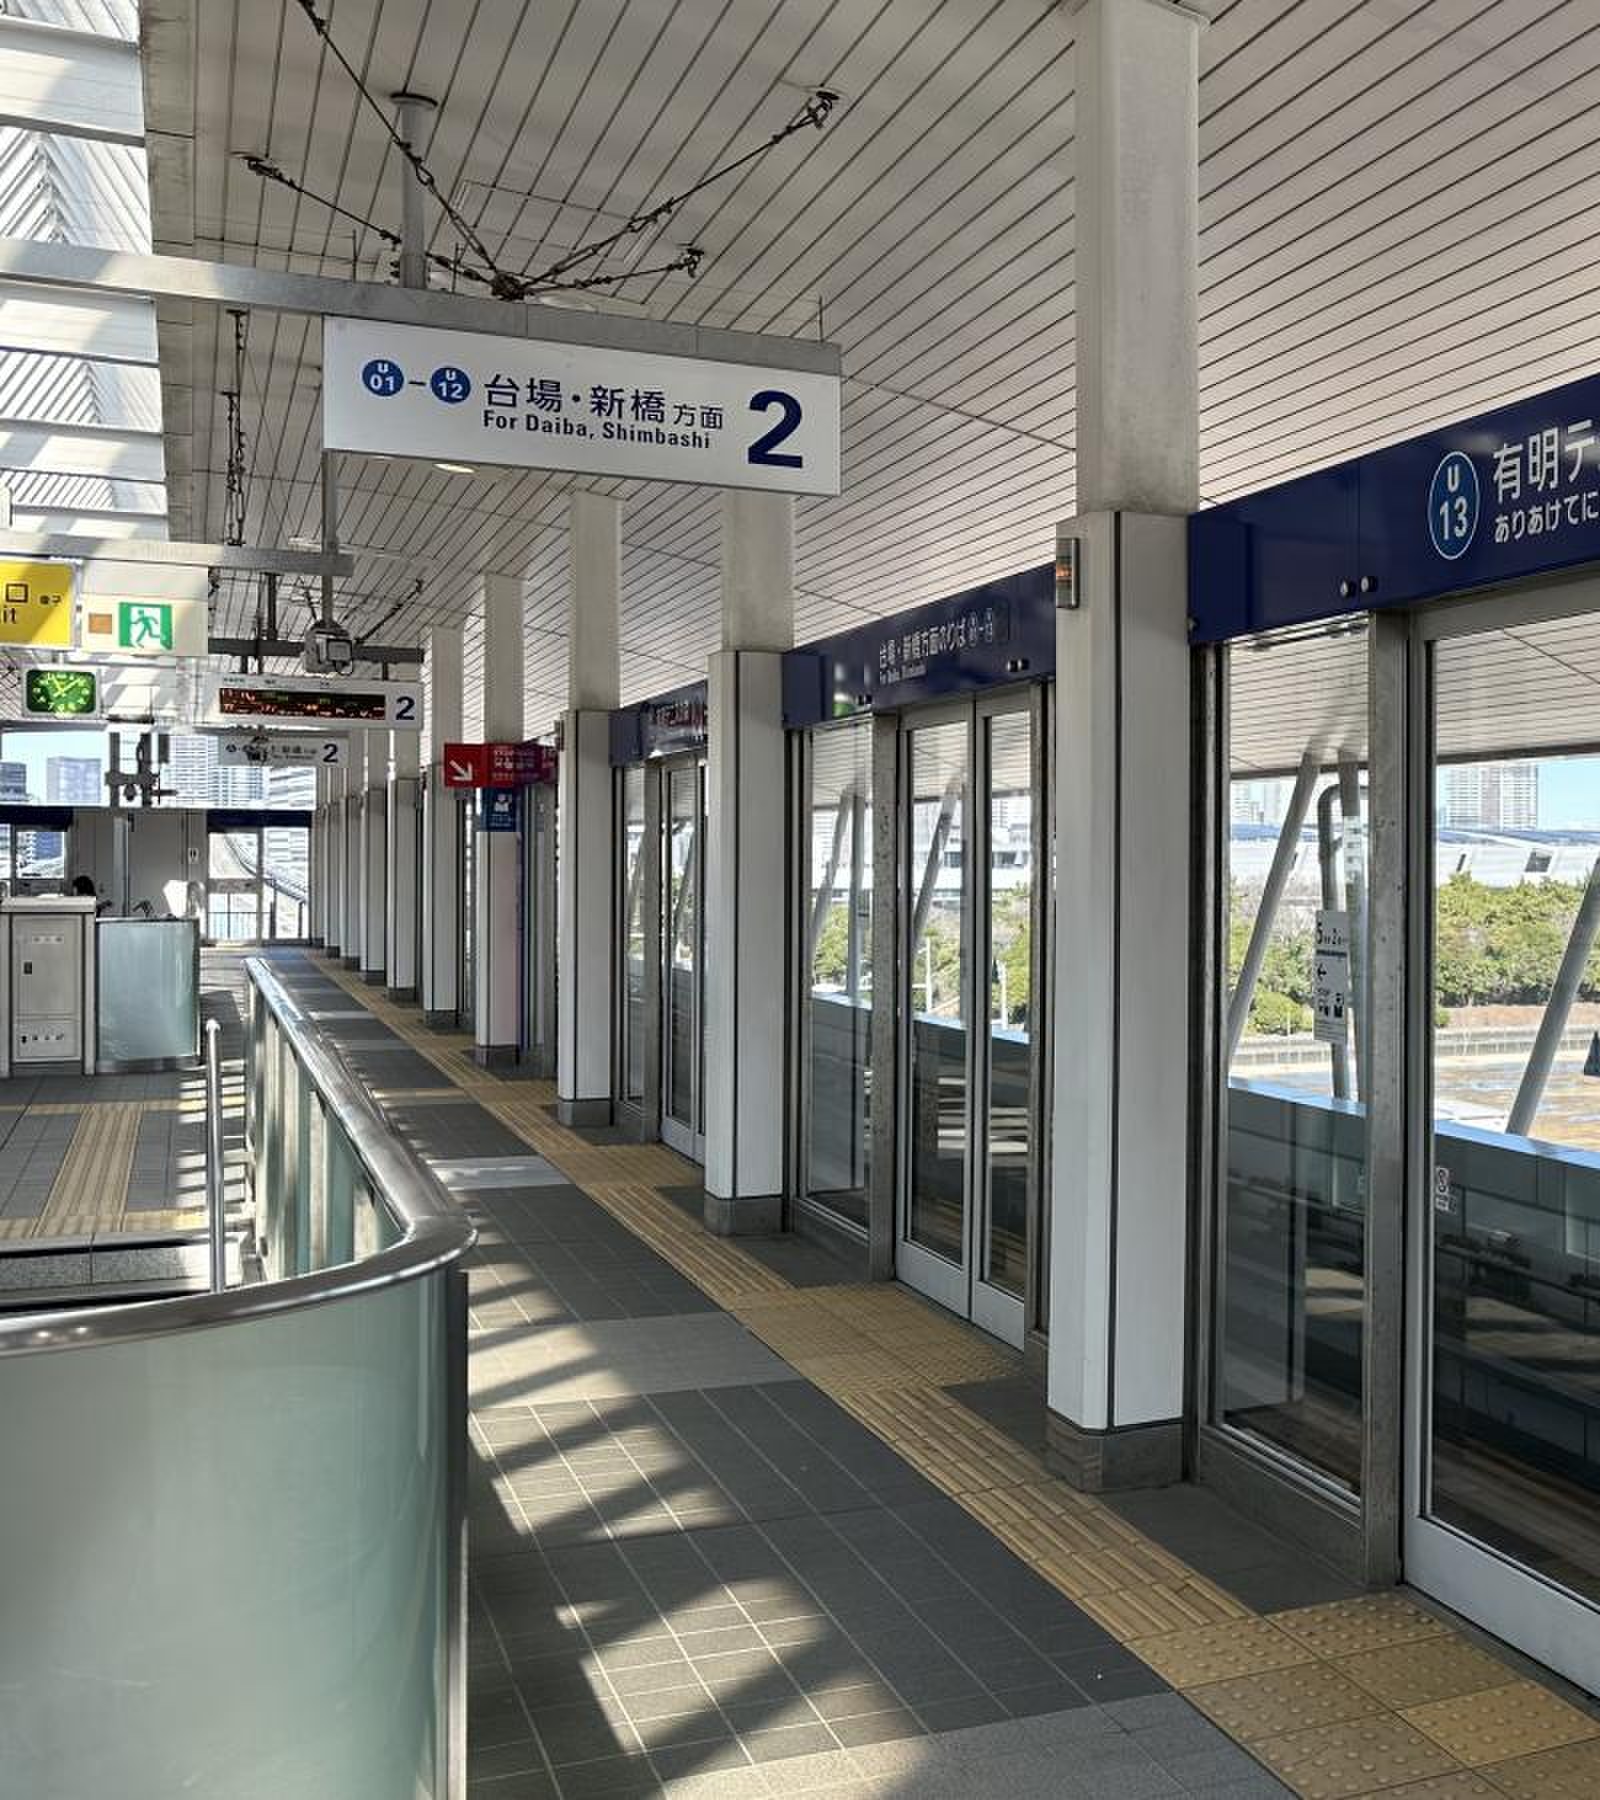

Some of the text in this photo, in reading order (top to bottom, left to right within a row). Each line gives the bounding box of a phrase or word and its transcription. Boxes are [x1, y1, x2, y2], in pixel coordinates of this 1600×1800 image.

[370, 374, 395, 391] 01
[438, 382, 463, 399] 12
[483, 410, 710, 449] For Daiba, Shimbashi
[748, 390, 803, 469] 2
[1448, 466, 1460, 492] U
[1439, 496, 1468, 540] 13
[0, 605, 17, 625] it
[395, 696, 415, 721] 2
[322, 743, 339, 763] 2
